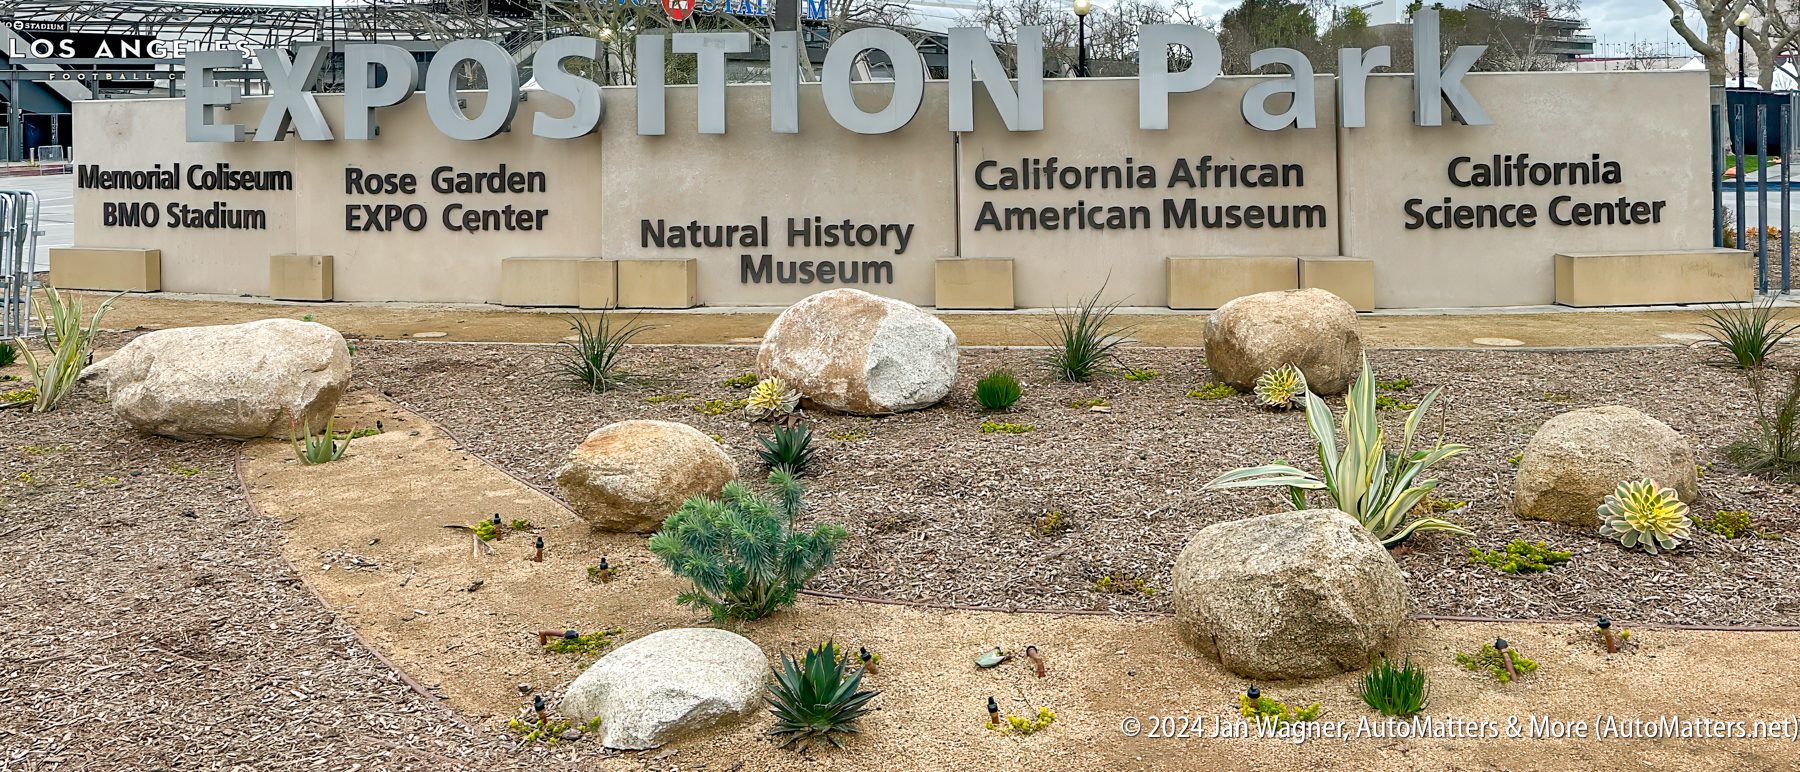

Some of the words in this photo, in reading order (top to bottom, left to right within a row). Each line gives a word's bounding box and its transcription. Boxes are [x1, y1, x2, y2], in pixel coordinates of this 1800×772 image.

[9, 38, 76, 58] LOS
[49, 73, 152, 81] FOOTBALL
[186, 26, 1043, 143] EXPOSITION
[1139, 7, 1493, 131] Park
[77, 163, 180, 191] Memorial
[186, 163, 293, 191] Coliseum
[345, 168, 417, 195] Rose
[431, 164, 546, 194] Garden
[974, 156, 1157, 191] California
[1167, 156, 1304, 189] African
[1447, 153, 1622, 187] California
[103, 202, 160, 228] BMO
[166, 201, 266, 229] Stadium
[345, 204, 427, 232] EXPO
[442, 203, 549, 233] Center
[974, 200, 1151, 232] American
[1162, 199, 1327, 229] Museum
[1404, 197, 1537, 230] Science
[1548, 195, 1666, 227] Center
[641, 216, 768, 248] Natural
[787, 216, 915, 254] History
[741, 254, 893, 284] Museum
